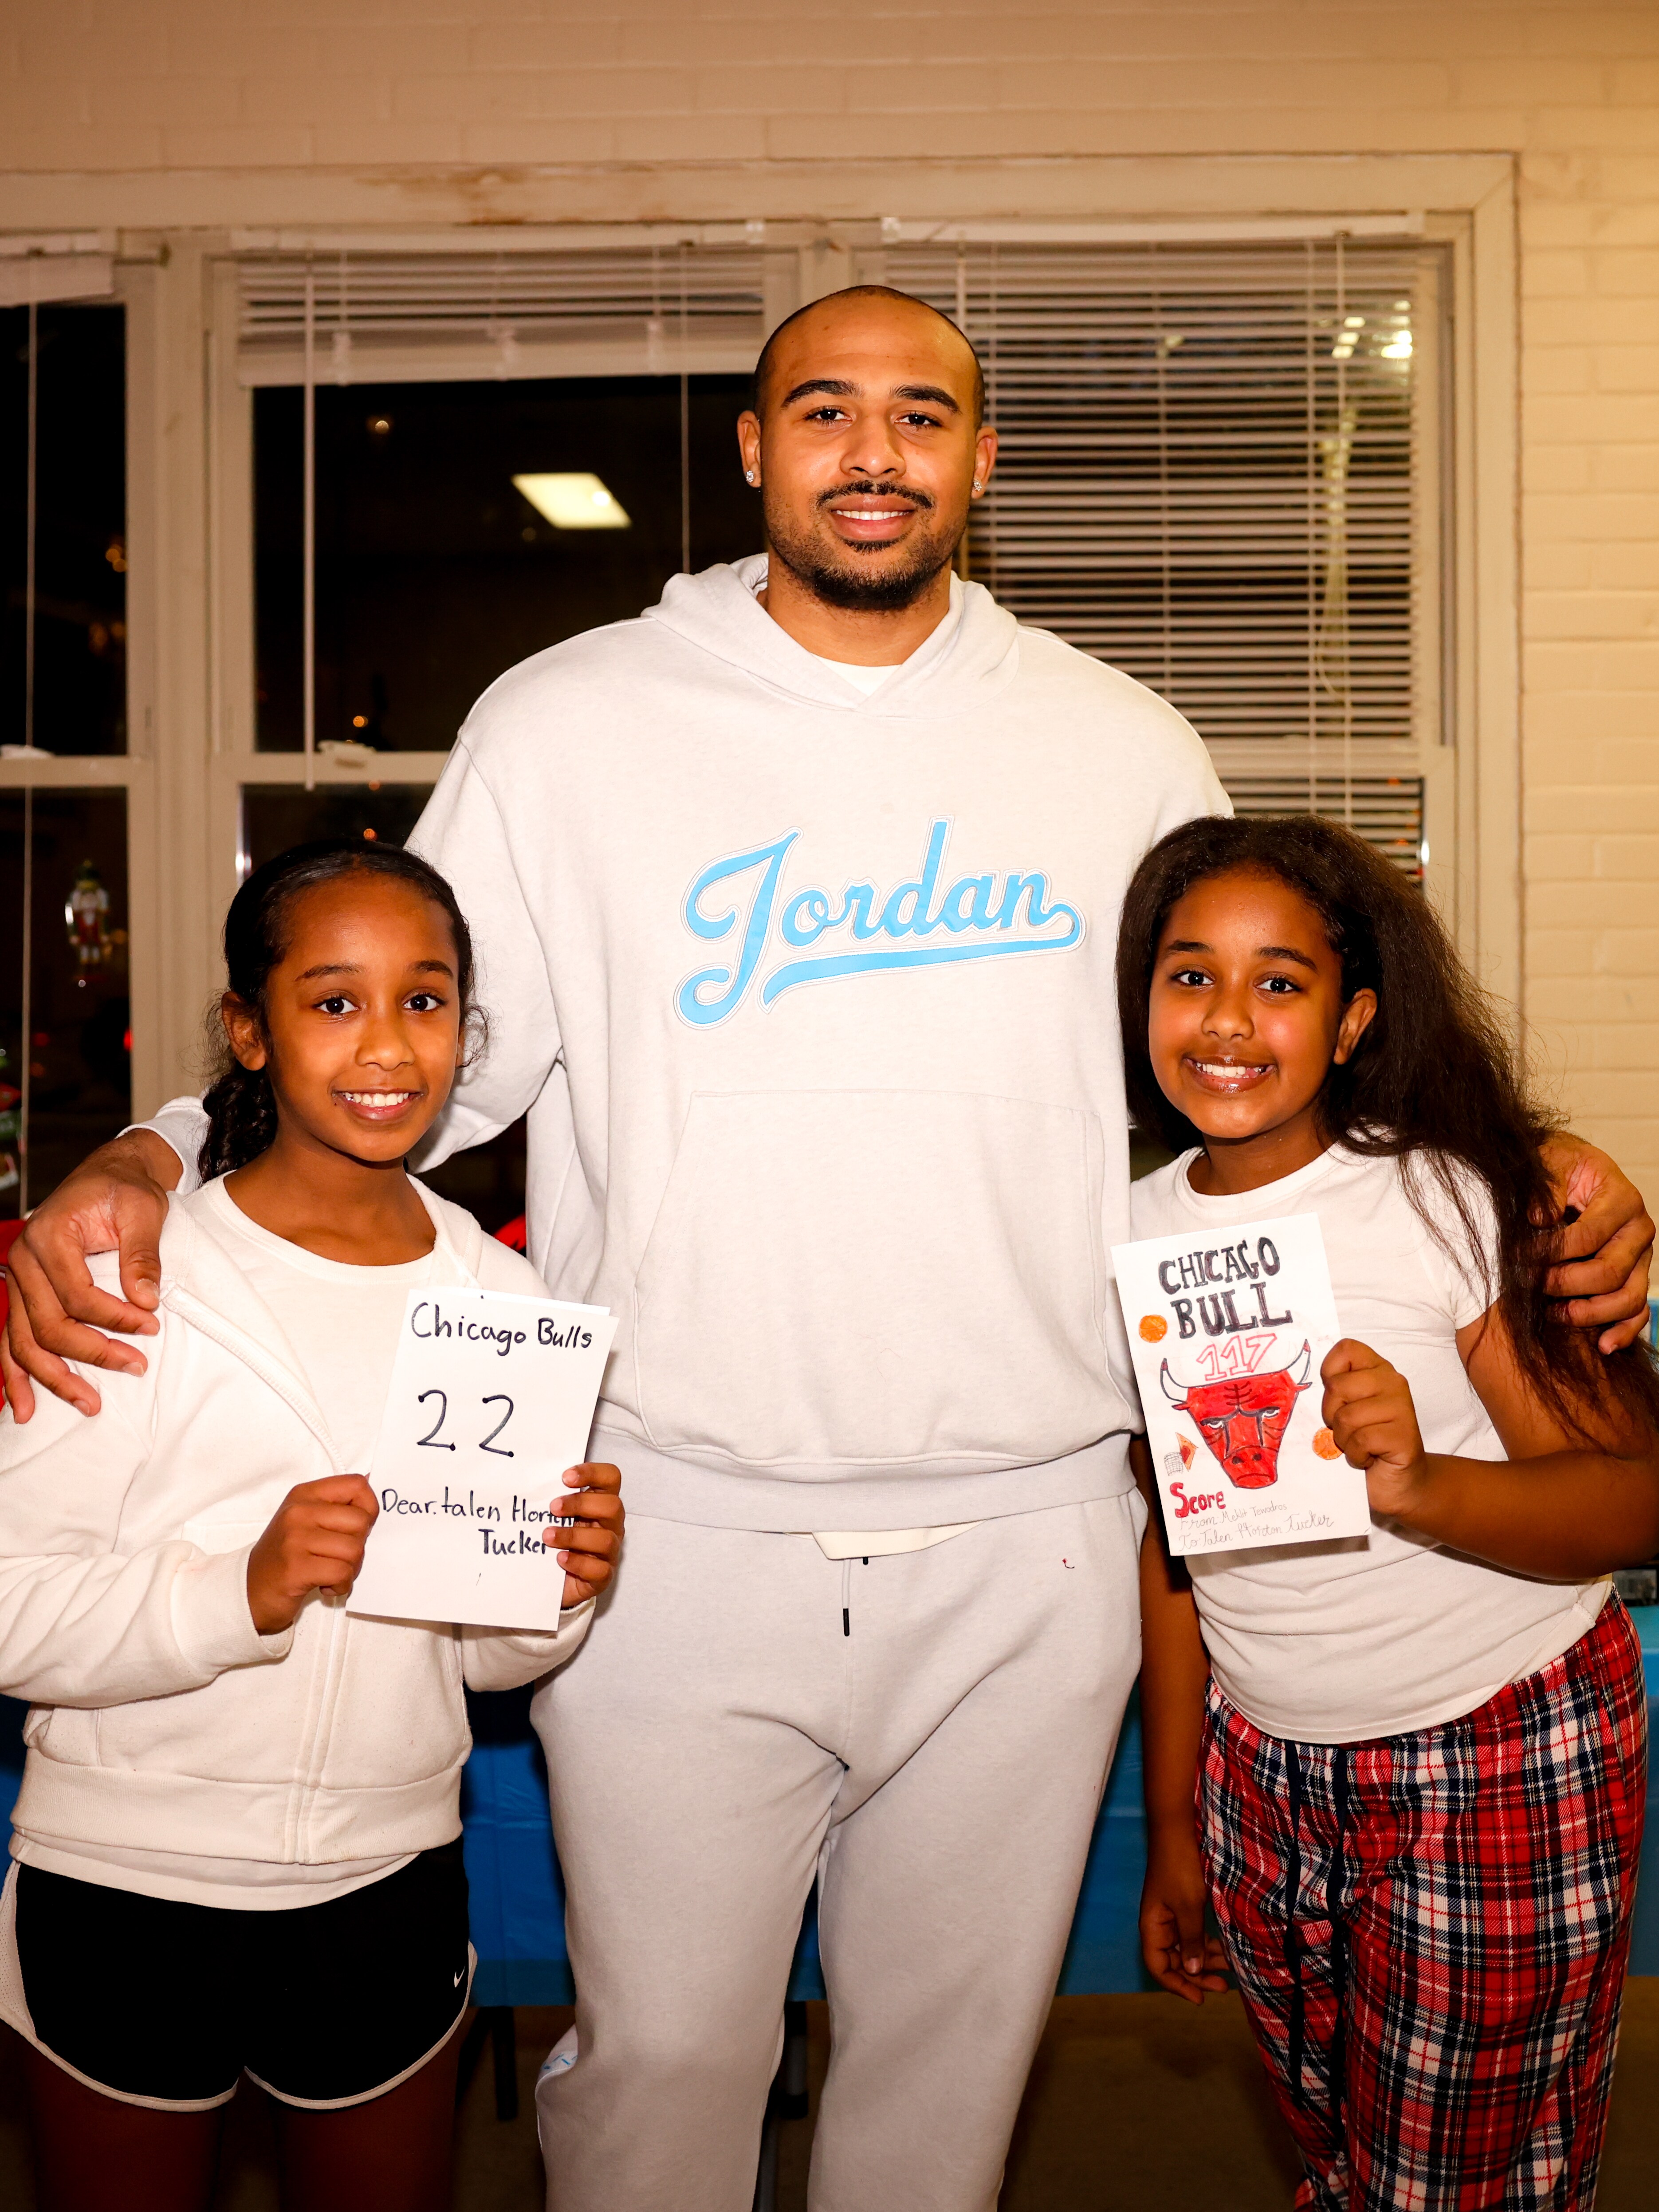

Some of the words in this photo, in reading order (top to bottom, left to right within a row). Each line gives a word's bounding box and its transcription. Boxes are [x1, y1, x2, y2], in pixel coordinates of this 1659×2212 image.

[673, 815, 1086, 1030] Jordan
[1158, 1237, 1281, 1294] CHICAGO
[411, 1302, 527, 1356] Chicago
[538, 1317, 592, 1348] Bulls
[1170, 1281, 1293, 1339] BULL
[1196, 1333, 1277, 1381] 117
[1169, 1482, 1226, 1518] Score
[1284, 1510, 1335, 1533] Tucker
[478, 1528, 546, 1555] Tucker
